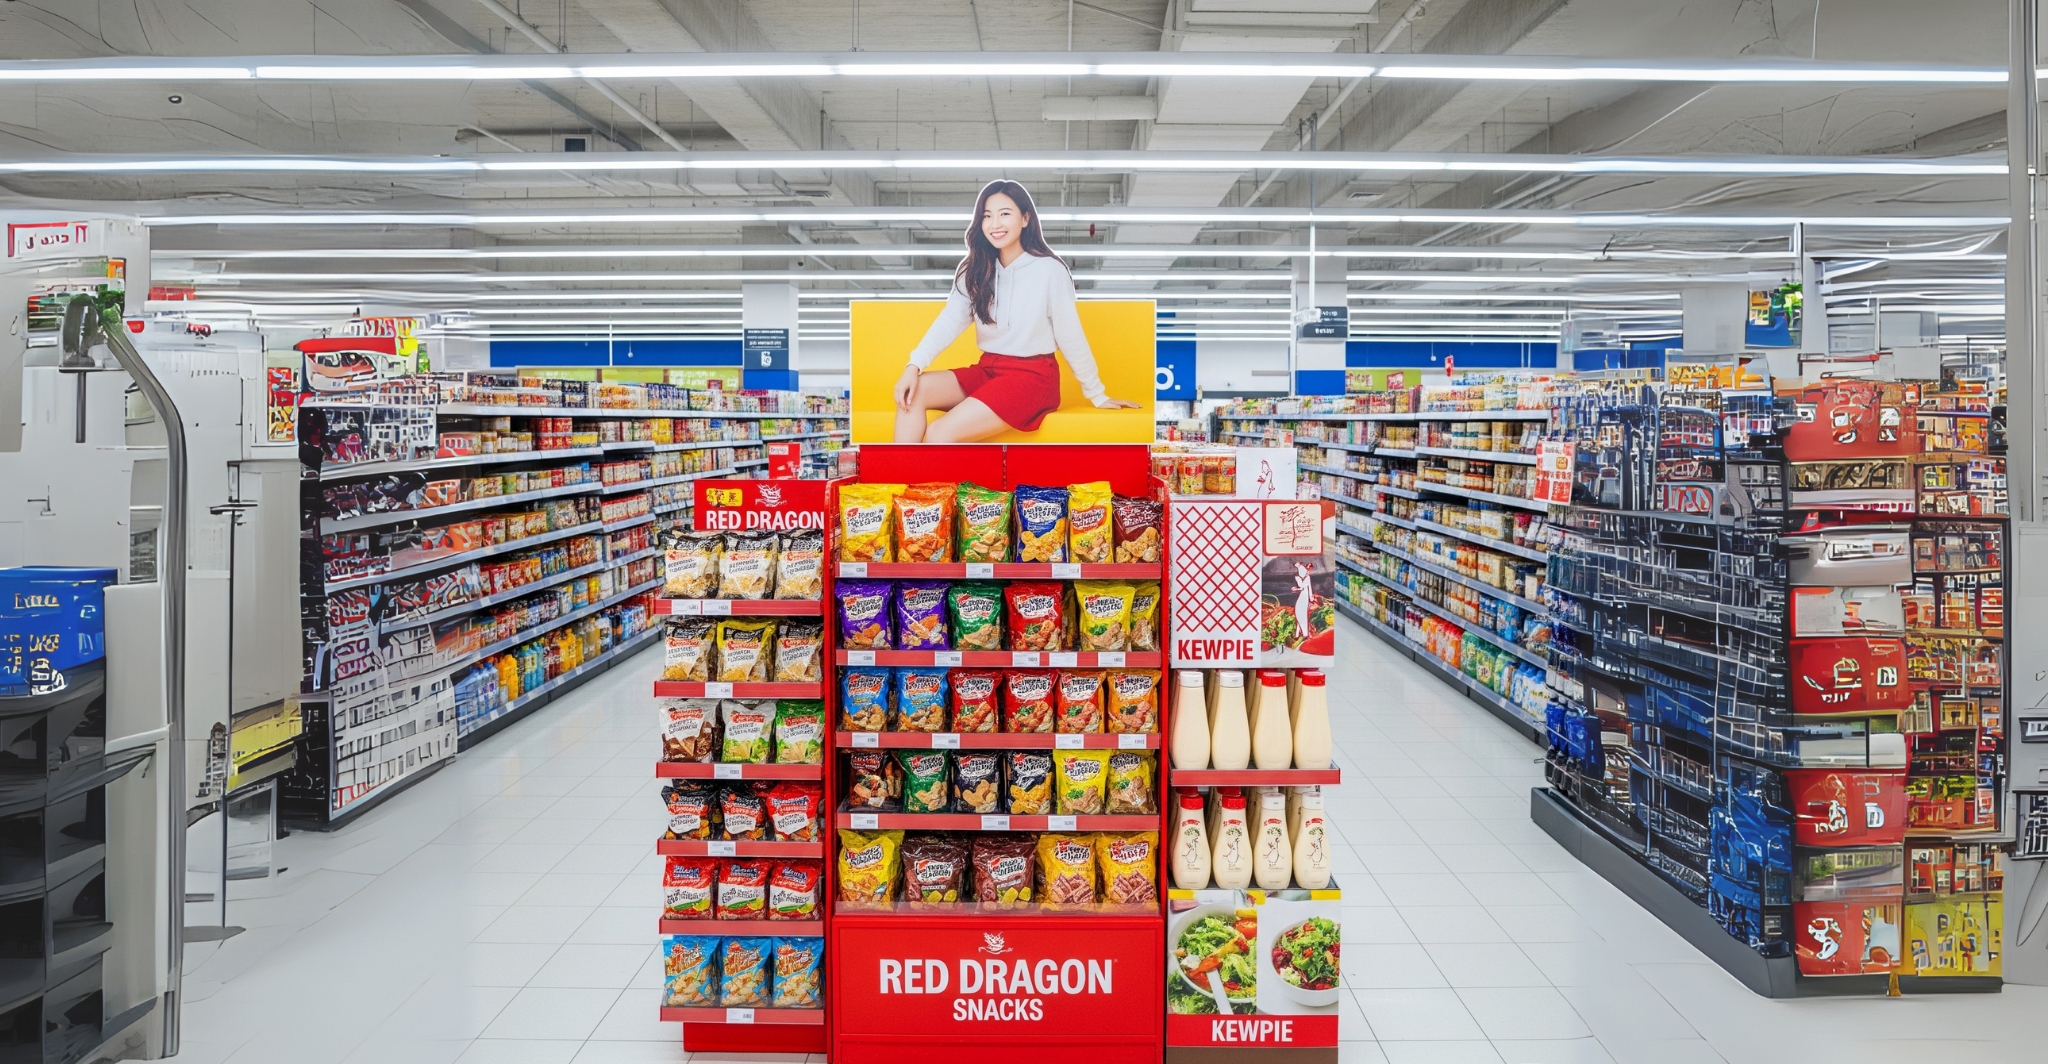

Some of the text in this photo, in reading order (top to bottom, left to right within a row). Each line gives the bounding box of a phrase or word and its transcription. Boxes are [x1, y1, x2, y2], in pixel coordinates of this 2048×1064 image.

[706, 510, 742, 530] RED
[746, 510, 825, 530] DRAGON
[1178, 639, 1254, 661] KEWPIE
[879, 958, 1113, 995] RED DRAGON
[953, 998, 1044, 1021] SNACKS
[1211, 1019, 1293, 1043] KEWPIE
